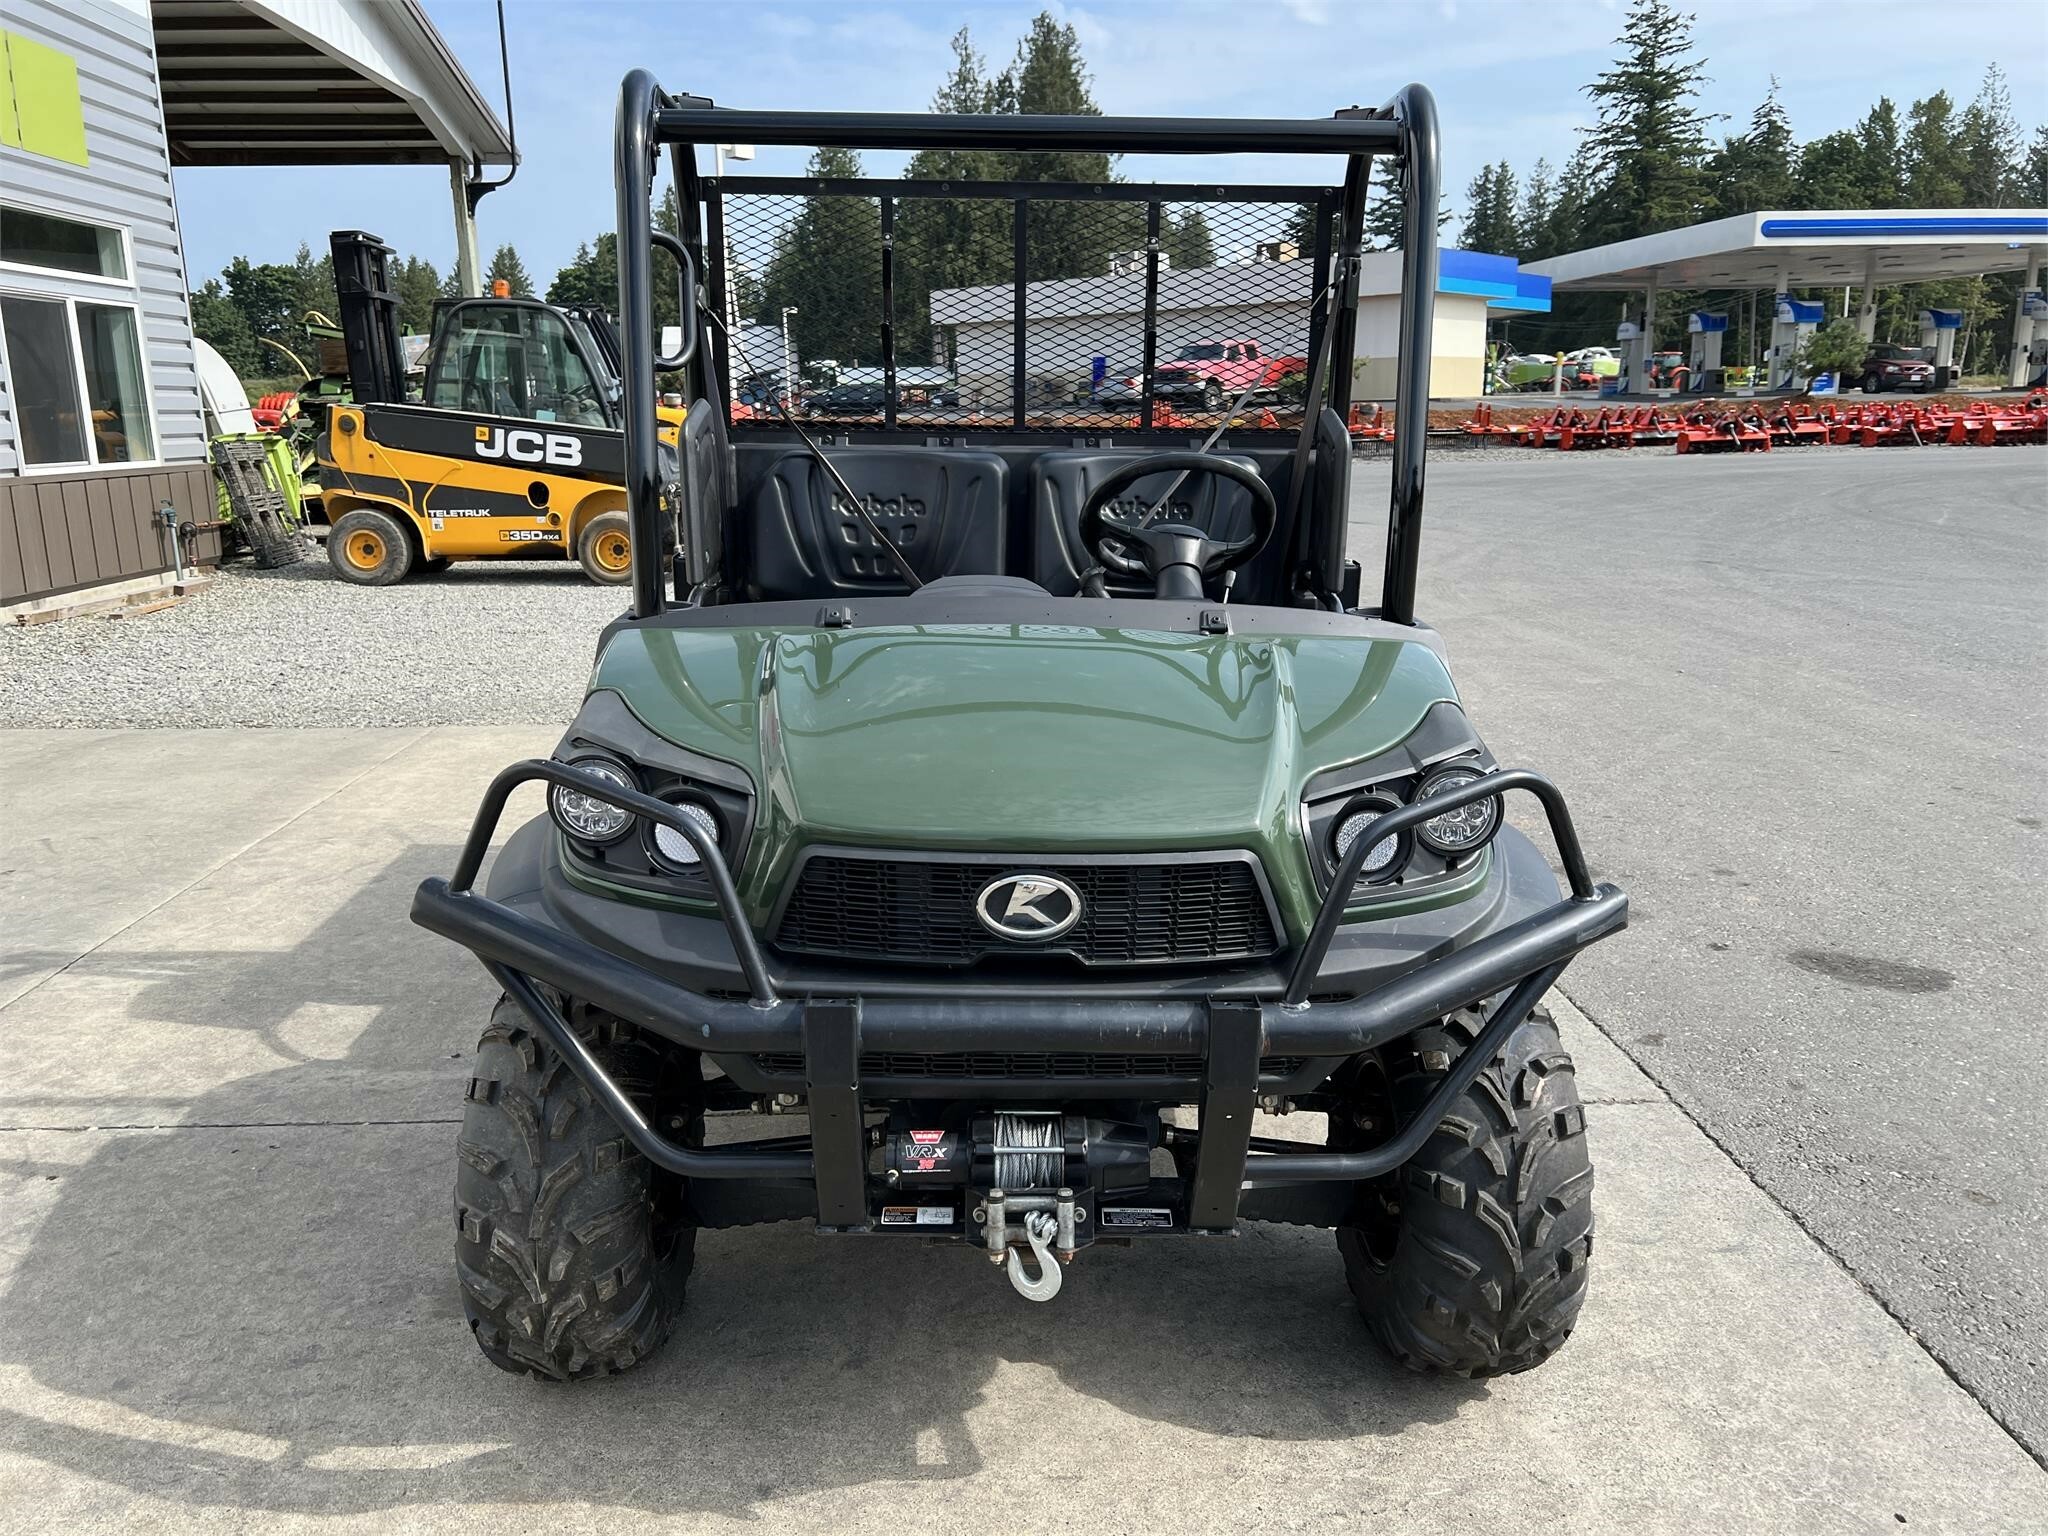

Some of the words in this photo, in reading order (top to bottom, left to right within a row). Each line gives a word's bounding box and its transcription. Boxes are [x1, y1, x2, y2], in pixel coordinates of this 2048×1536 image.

[475, 428, 583, 467] JCB
[428, 508, 491, 518] TELETRUK
[509, 530, 542, 541] 35D
